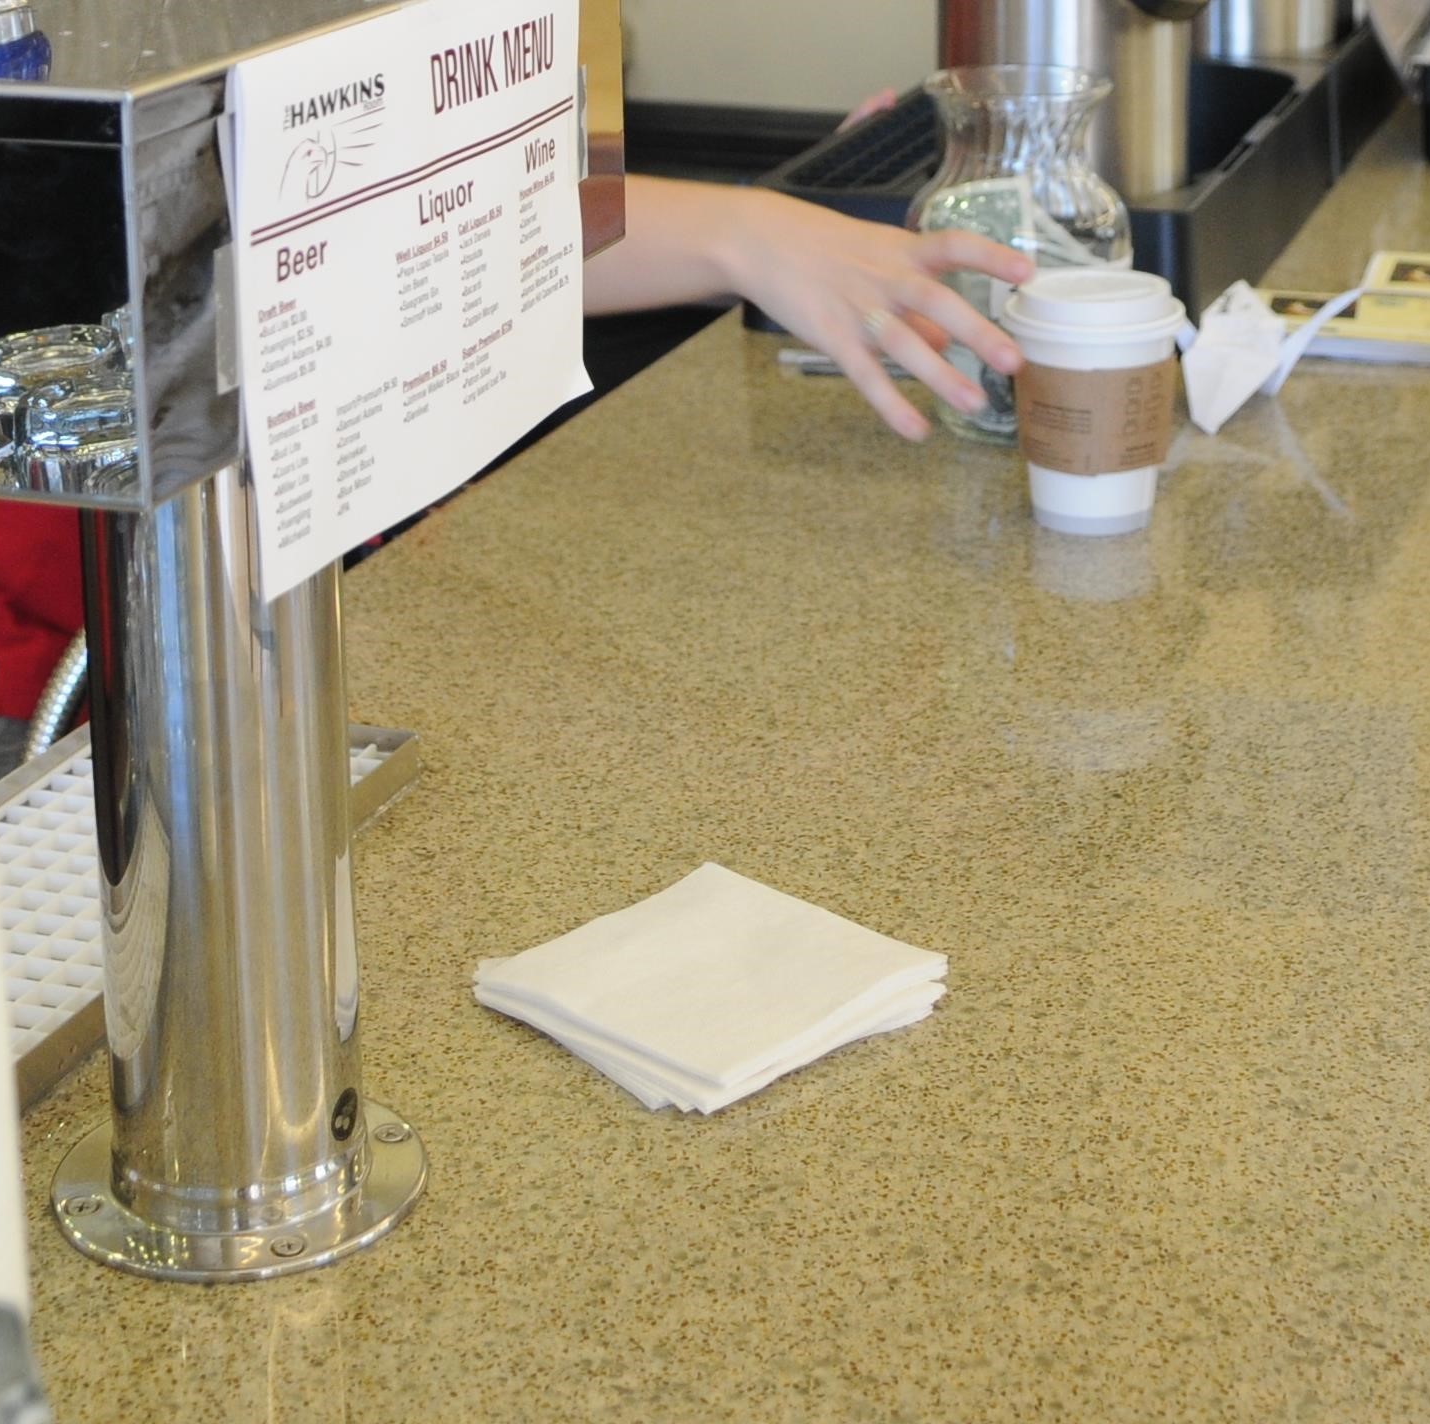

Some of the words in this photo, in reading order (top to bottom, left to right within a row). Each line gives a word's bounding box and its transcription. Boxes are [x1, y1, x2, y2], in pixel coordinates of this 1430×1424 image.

[430, 34, 499, 115] DRINK
[502, 13, 554, 88] MENU
[291, 73, 385, 128] HAWKINS
[524, 138, 555, 174] Wine
[418, 180, 473, 226] Liquor
[276, 241, 328, 283] Beer
